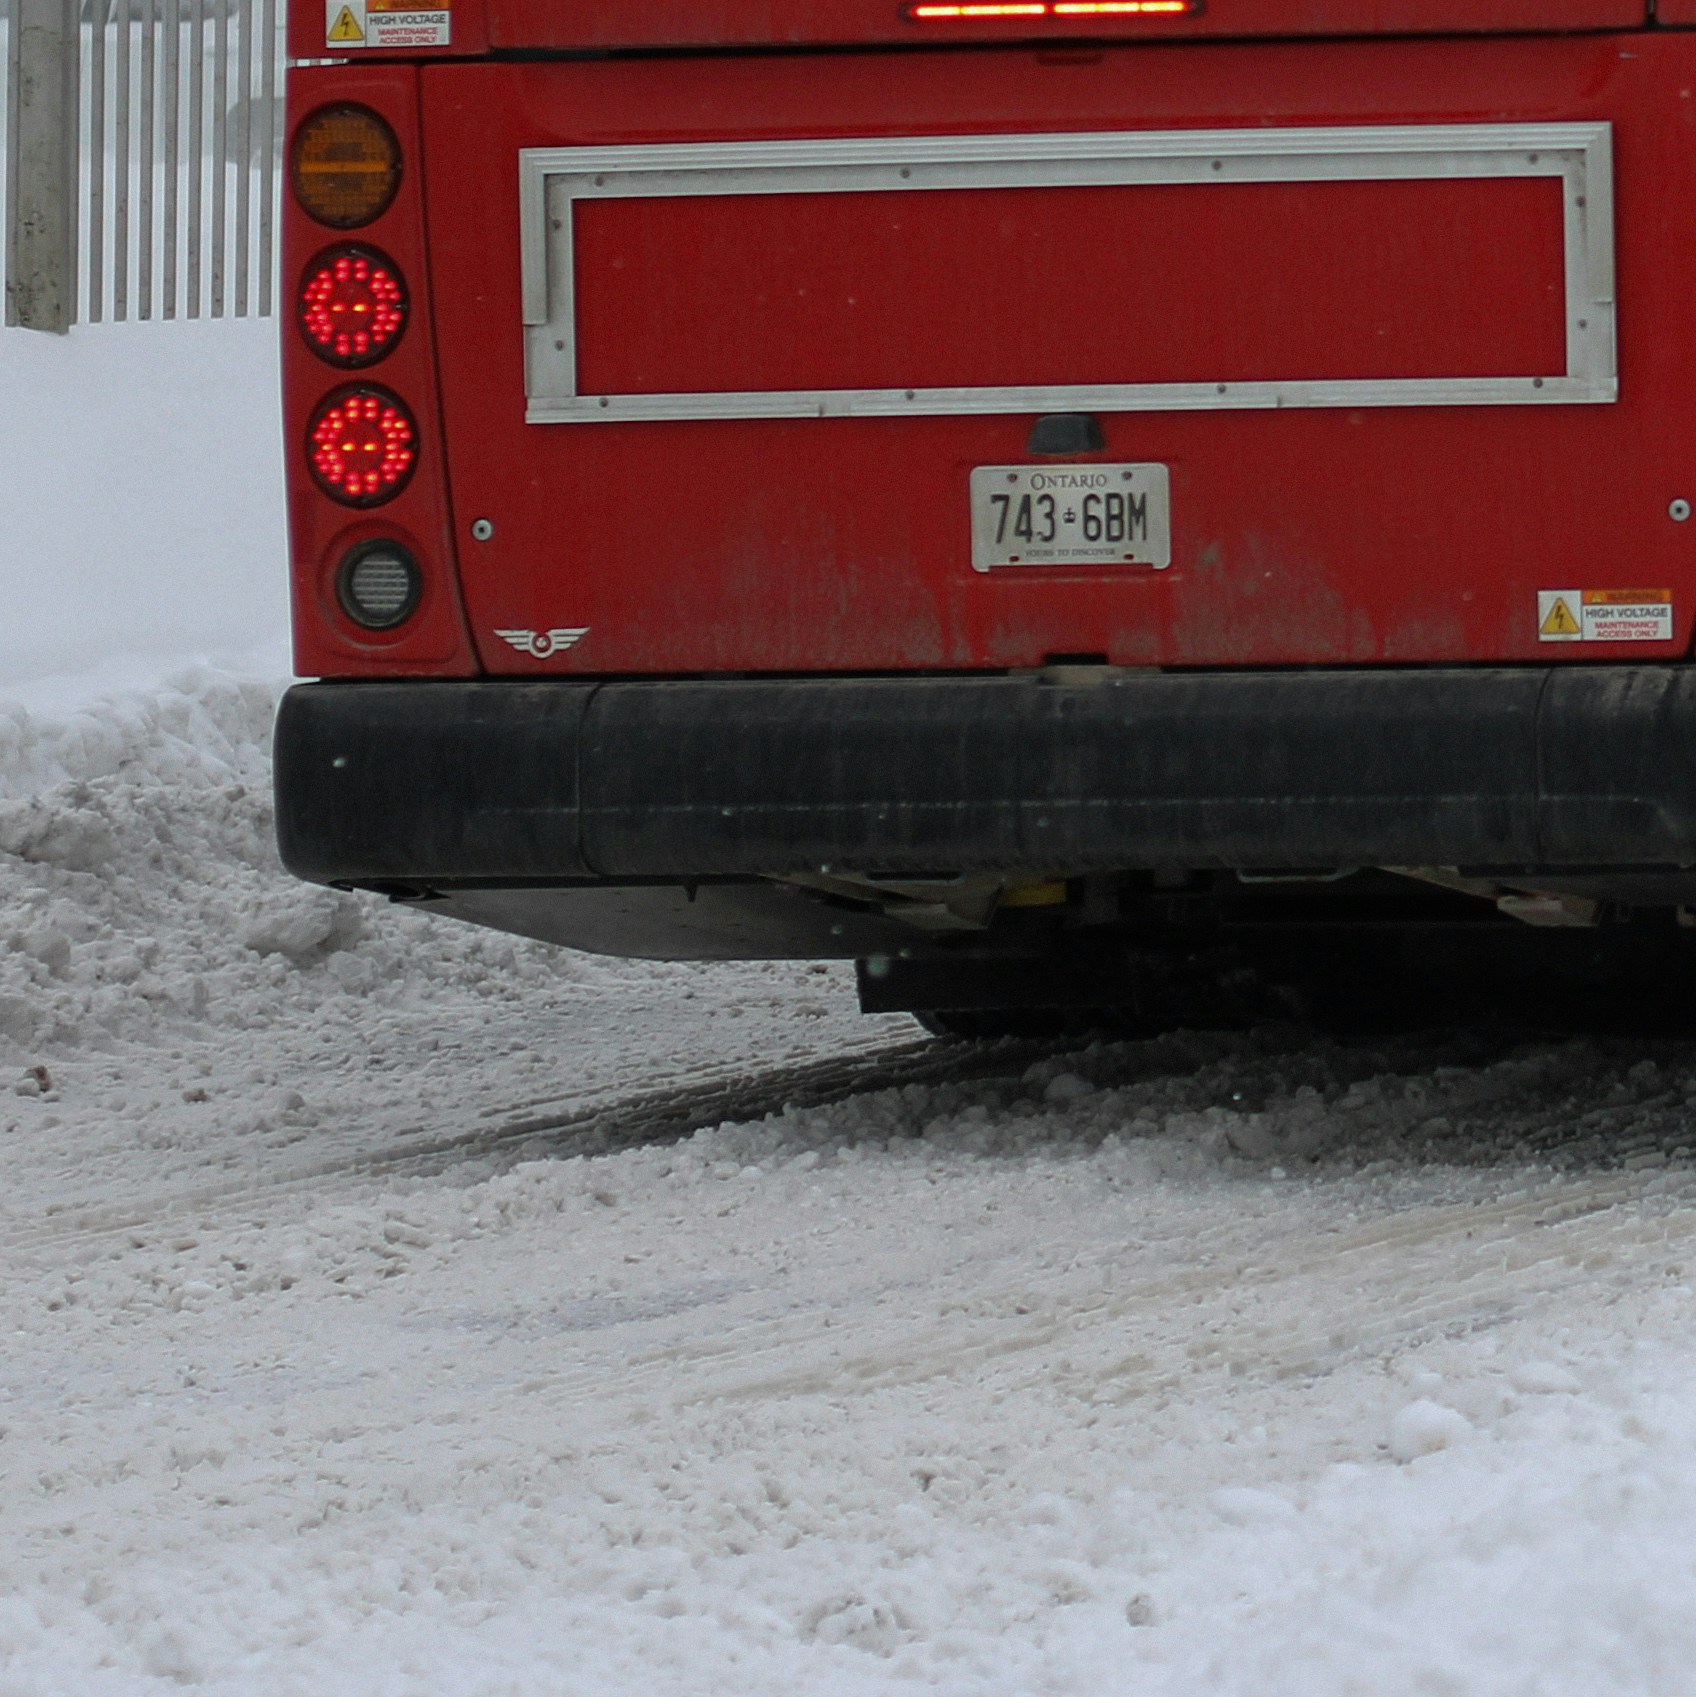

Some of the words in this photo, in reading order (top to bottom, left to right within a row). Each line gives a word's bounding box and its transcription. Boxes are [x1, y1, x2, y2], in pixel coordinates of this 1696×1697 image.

[369, 15, 396, 25] HIGH
[399, 14, 446, 25] VOLTAGE
[378, 27, 438, 35] MAINTENANCE
[414, 35, 437, 43] ONLY
[991, 493, 1055, 544] 743
[1083, 492, 1147, 542] 6BM
[1585, 608, 1613, 619] HIGH
[1616, 607, 1668, 618] VOLTAGE
[1595, 621, 1659, 629] MAINTENANCE
